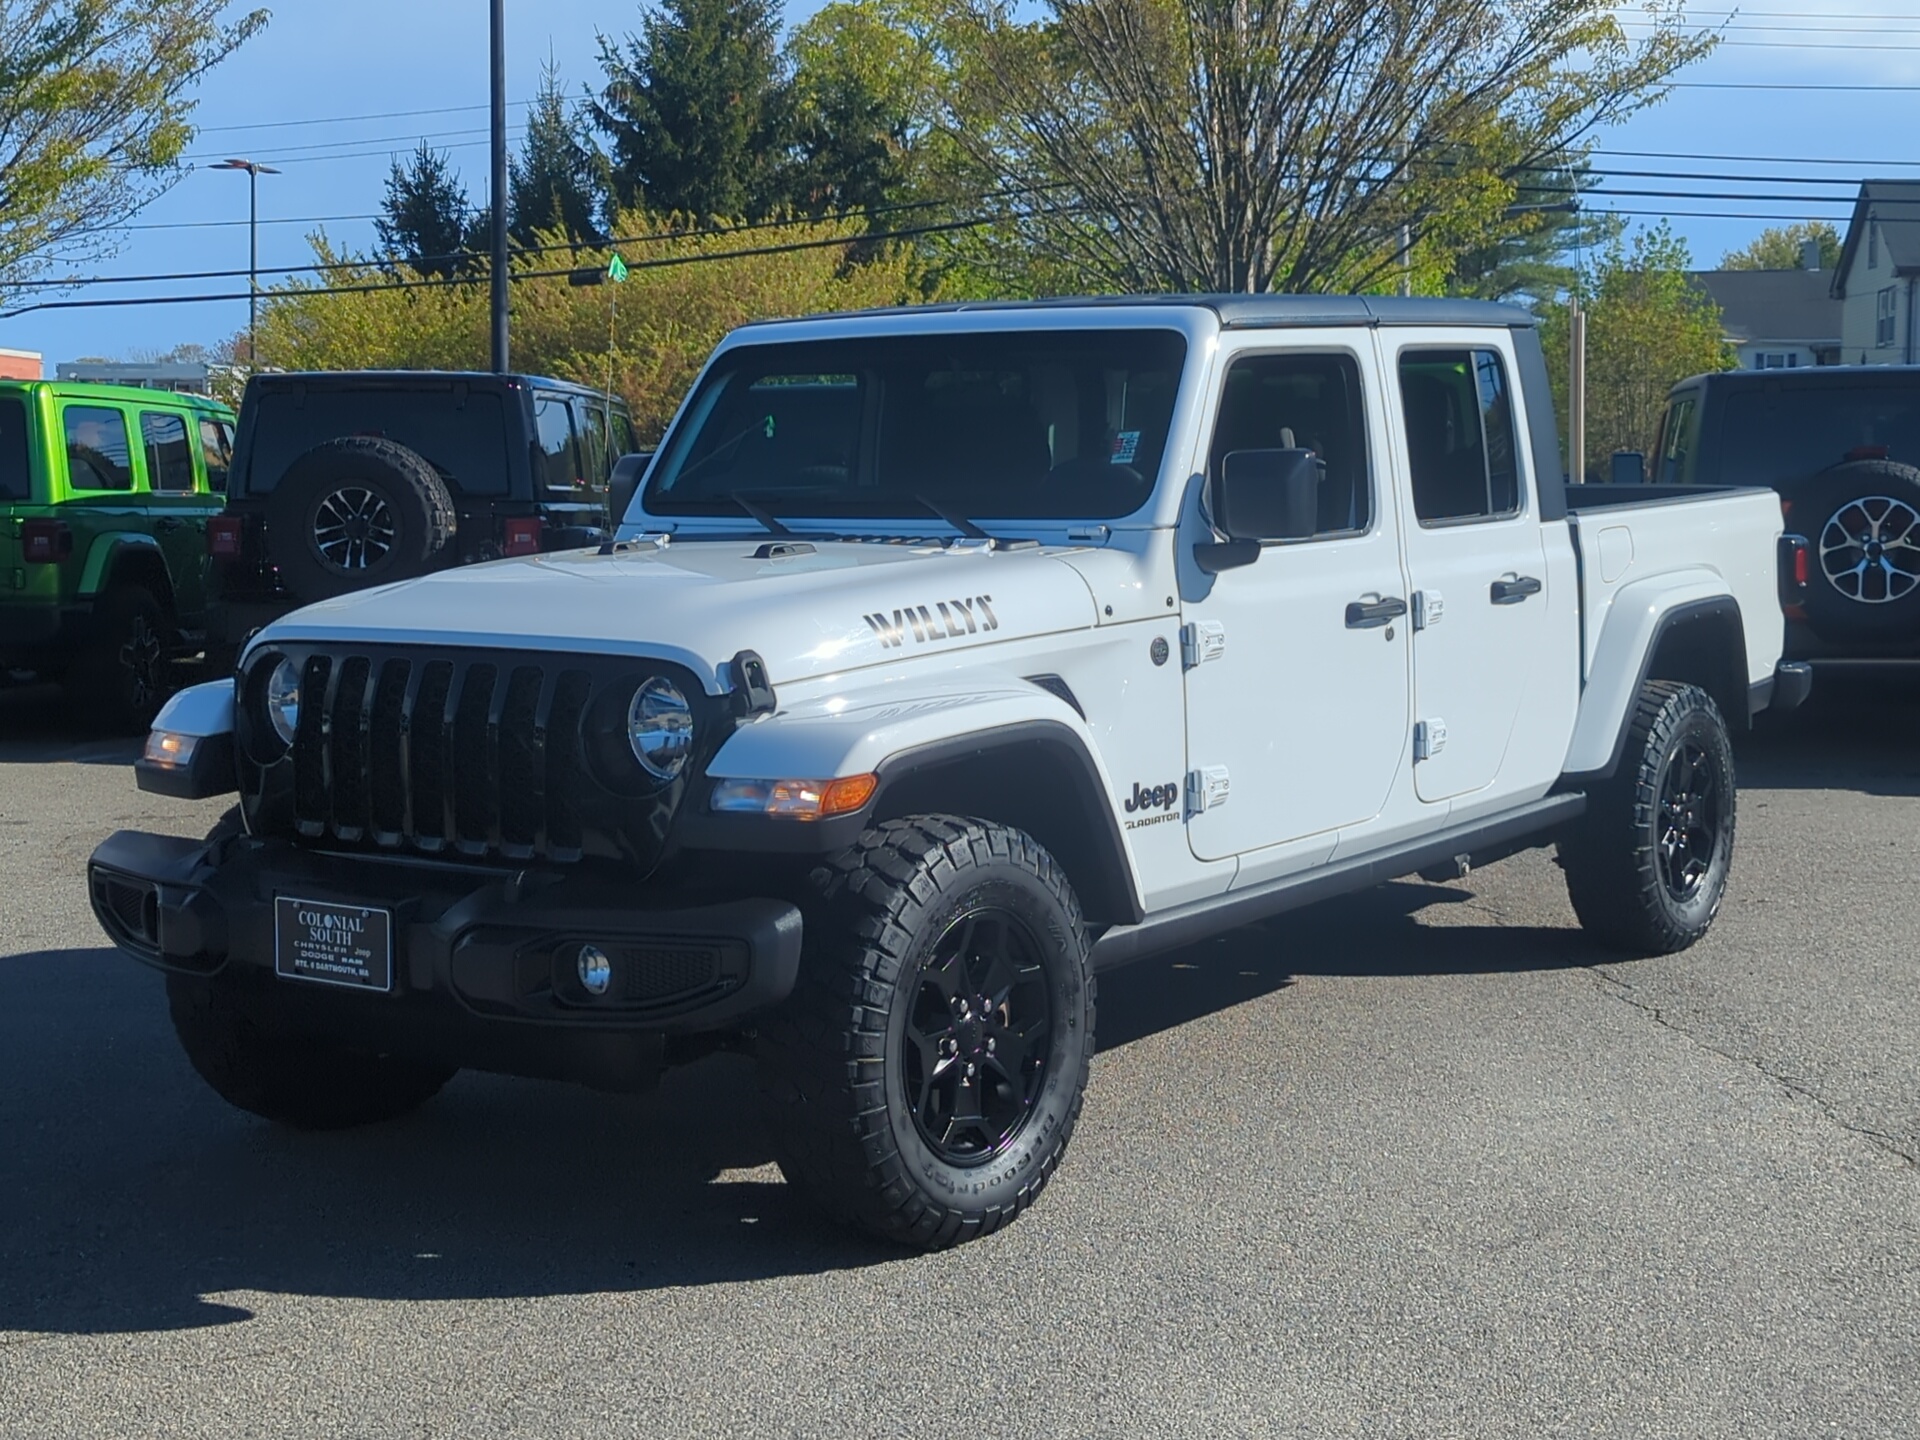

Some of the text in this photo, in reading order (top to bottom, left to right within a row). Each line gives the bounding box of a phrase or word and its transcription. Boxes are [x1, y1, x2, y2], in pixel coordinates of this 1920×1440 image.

[862, 594, 999, 649] WILLYS
[1124, 782, 1178, 813] Jeep
[1124, 812, 1180, 830] GLADIATOR
[299, 911, 364, 932] COLONIAL
[310, 927, 352, 946] SOUTH
[293, 940, 347, 954] CHRYSLER
[301, 950, 334, 961] DODGE
[359, 968, 369, 977] MA
